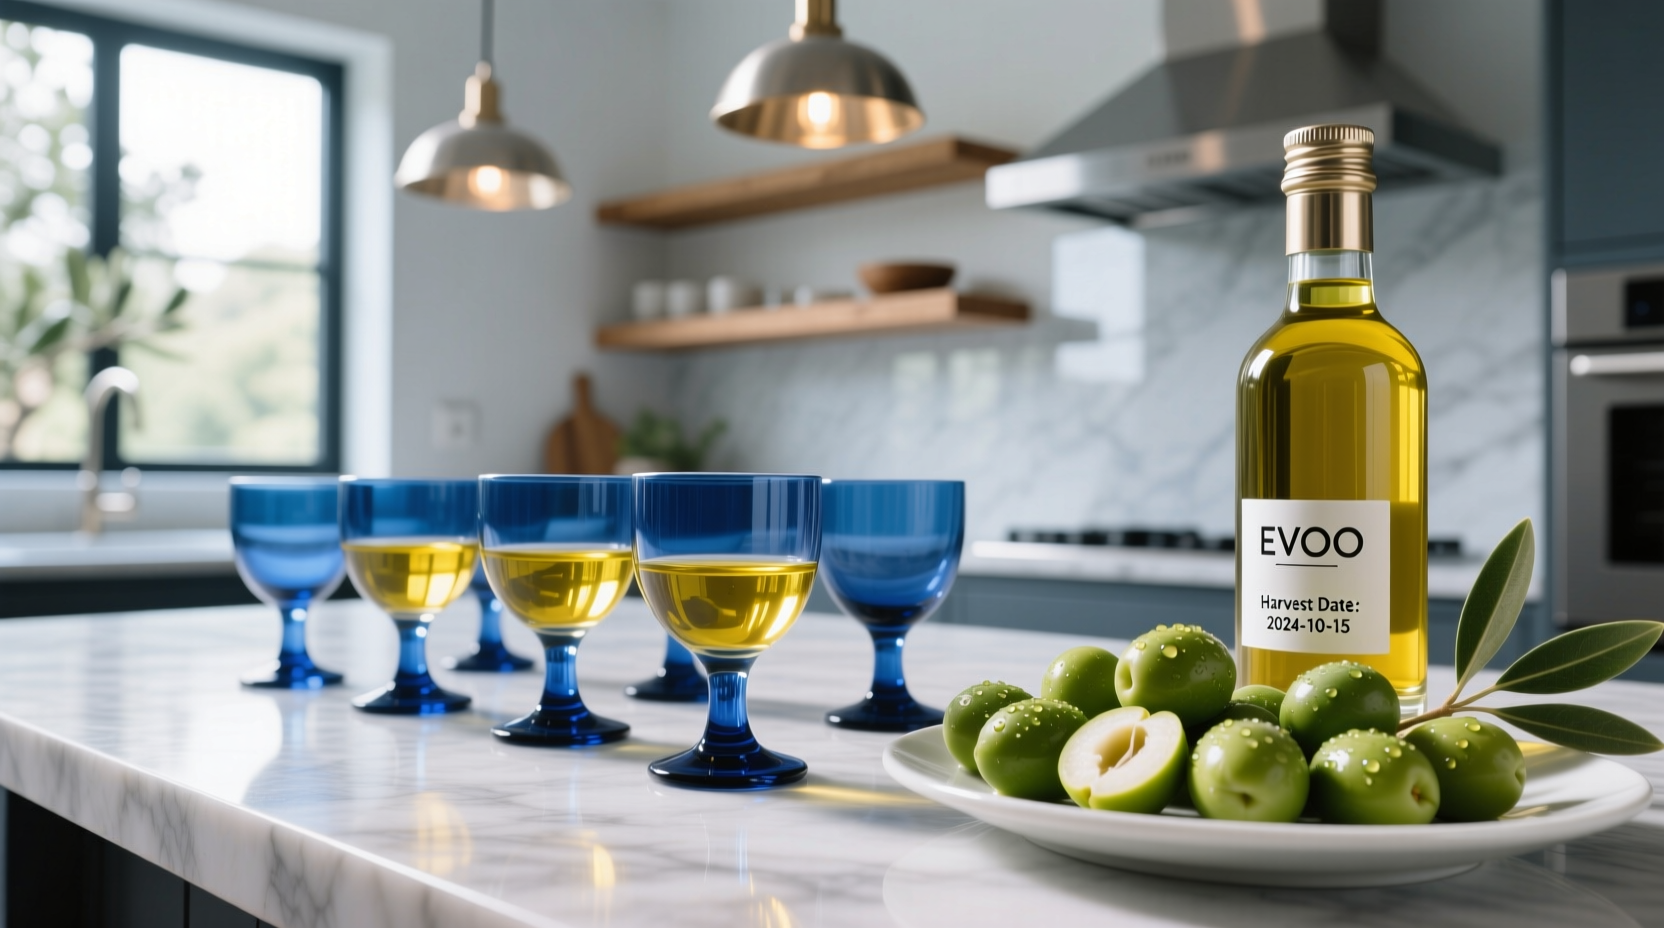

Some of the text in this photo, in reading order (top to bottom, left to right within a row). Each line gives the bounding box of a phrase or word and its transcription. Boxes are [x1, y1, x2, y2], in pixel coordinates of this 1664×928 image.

[1261, 526, 1364, 558] EVOO
[1261, 595, 1360, 612] Harvest Date:
[1267, 616, 1350, 633] 2024-10-15
